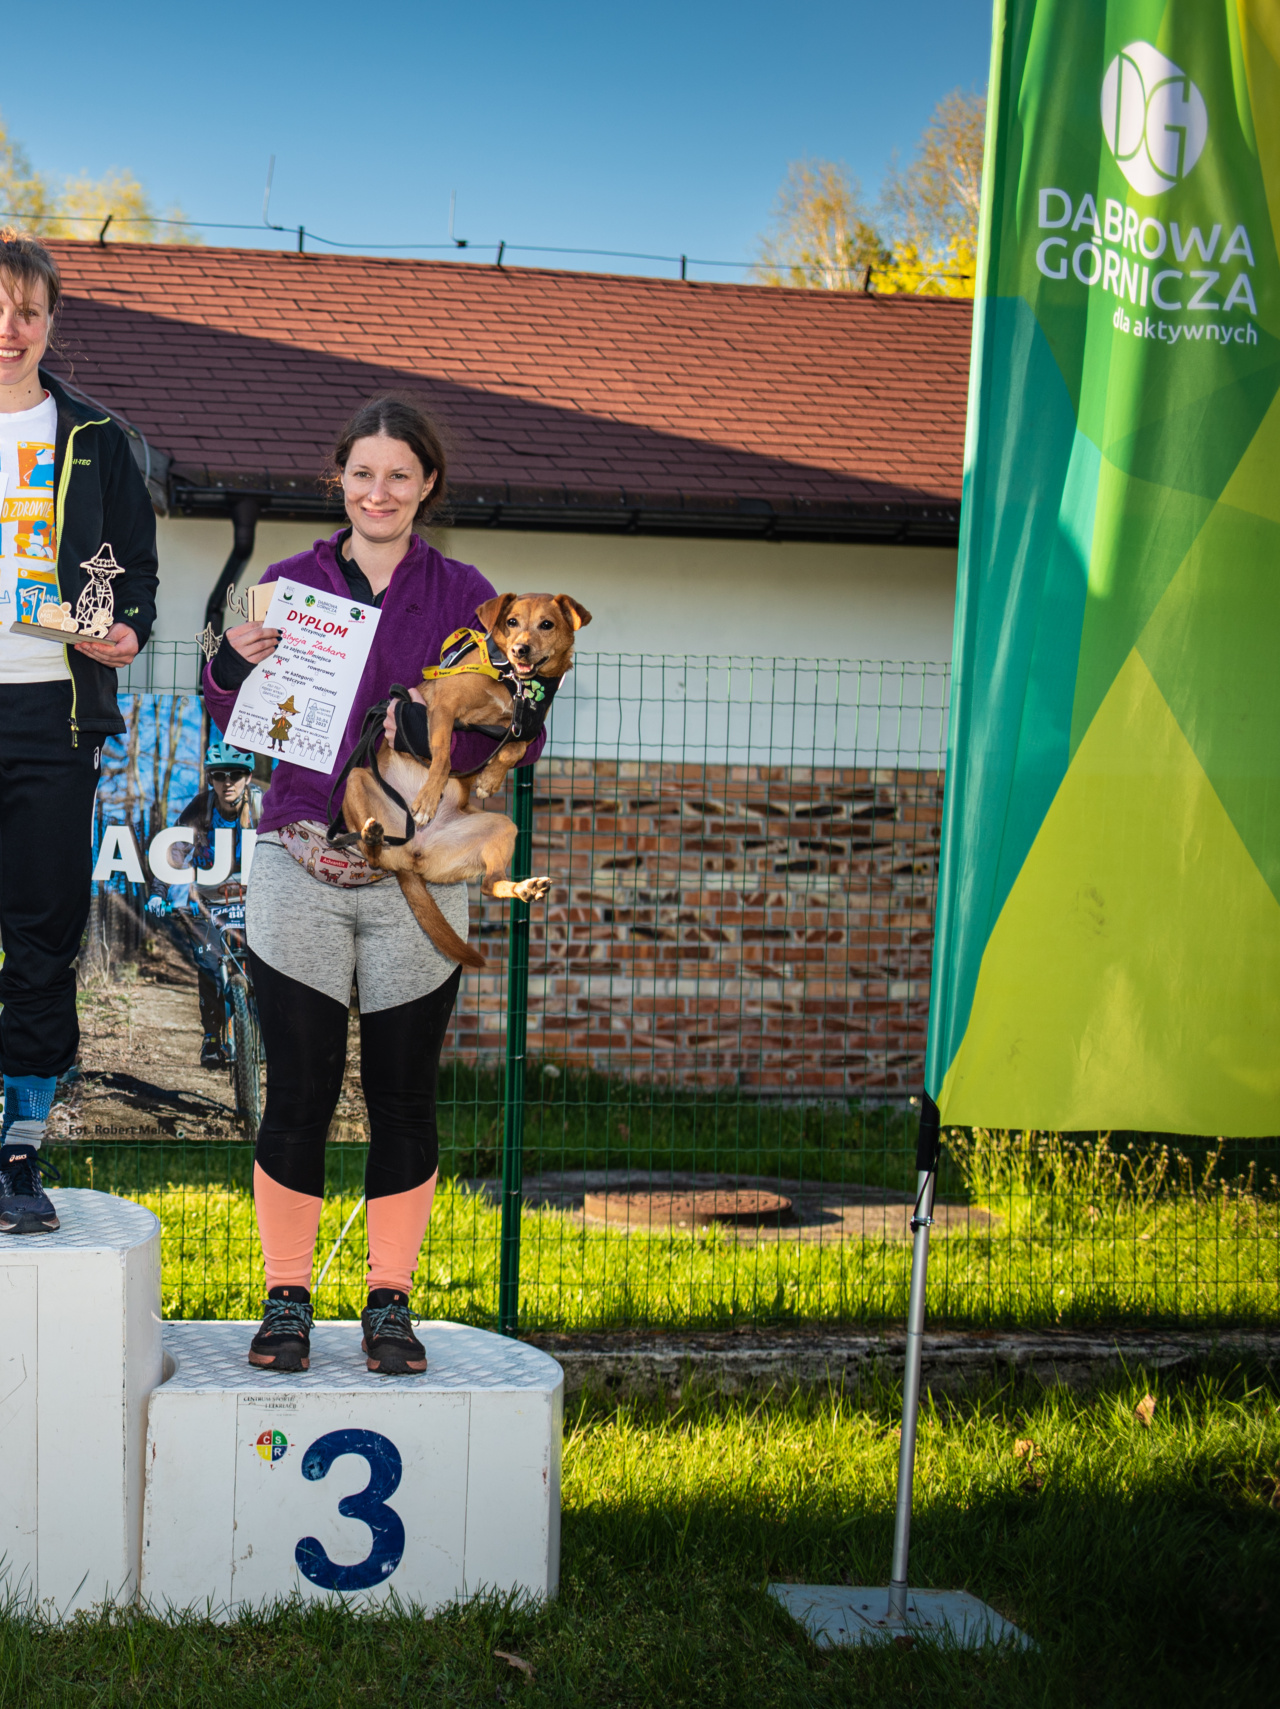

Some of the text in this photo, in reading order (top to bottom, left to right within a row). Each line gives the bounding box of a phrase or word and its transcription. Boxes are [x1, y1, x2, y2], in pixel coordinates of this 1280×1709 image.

[1113, 307, 1258, 346] dla aktywnych
[10, 500, 54, 518] ZDROWIE
[287, 610, 348, 638] DYPLOM
[301, 627, 326, 638] otrzymuje
[273, 654, 336, 677] pieszej rowerowej
[290, 647, 306, 655] zajęcie
[312, 654, 332, 663] miejsca
[262, 668, 276, 676] kobiet
[312, 685, 338, 696] rodzinnej
[94, 1125, 136, 1135] Robert
[295, 1428, 406, 1591] 3
